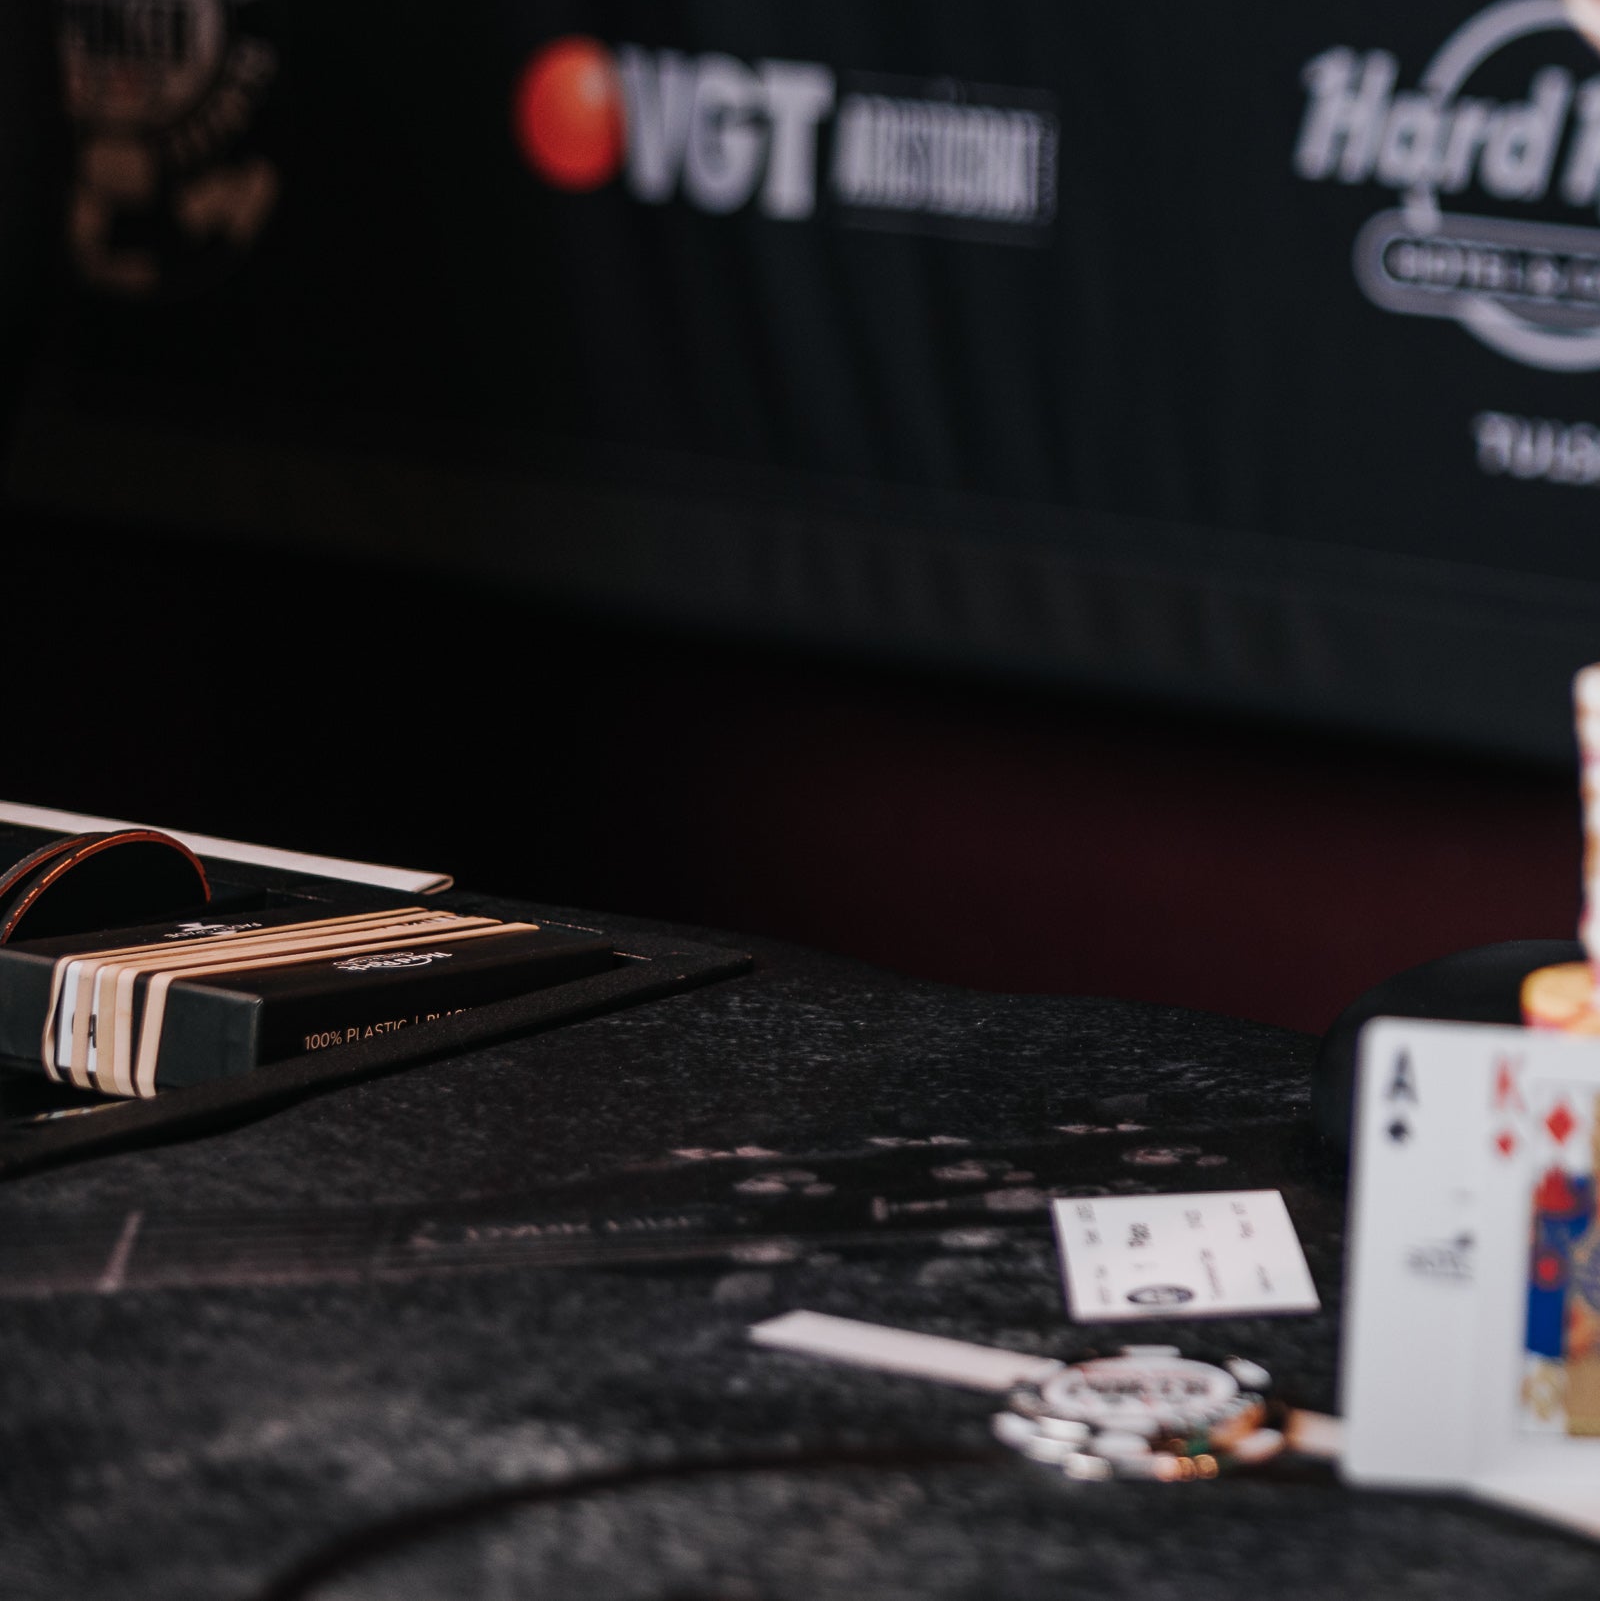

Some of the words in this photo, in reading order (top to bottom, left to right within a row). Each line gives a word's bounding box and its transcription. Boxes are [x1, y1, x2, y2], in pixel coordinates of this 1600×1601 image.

[612, 41, 837, 221] VGT
[1293, 44, 1577, 199] Hard
[303, 1029, 343, 1051] 100%
[1386, 1049, 1418, 1103] A
[1495, 1053, 1526, 1113] K
